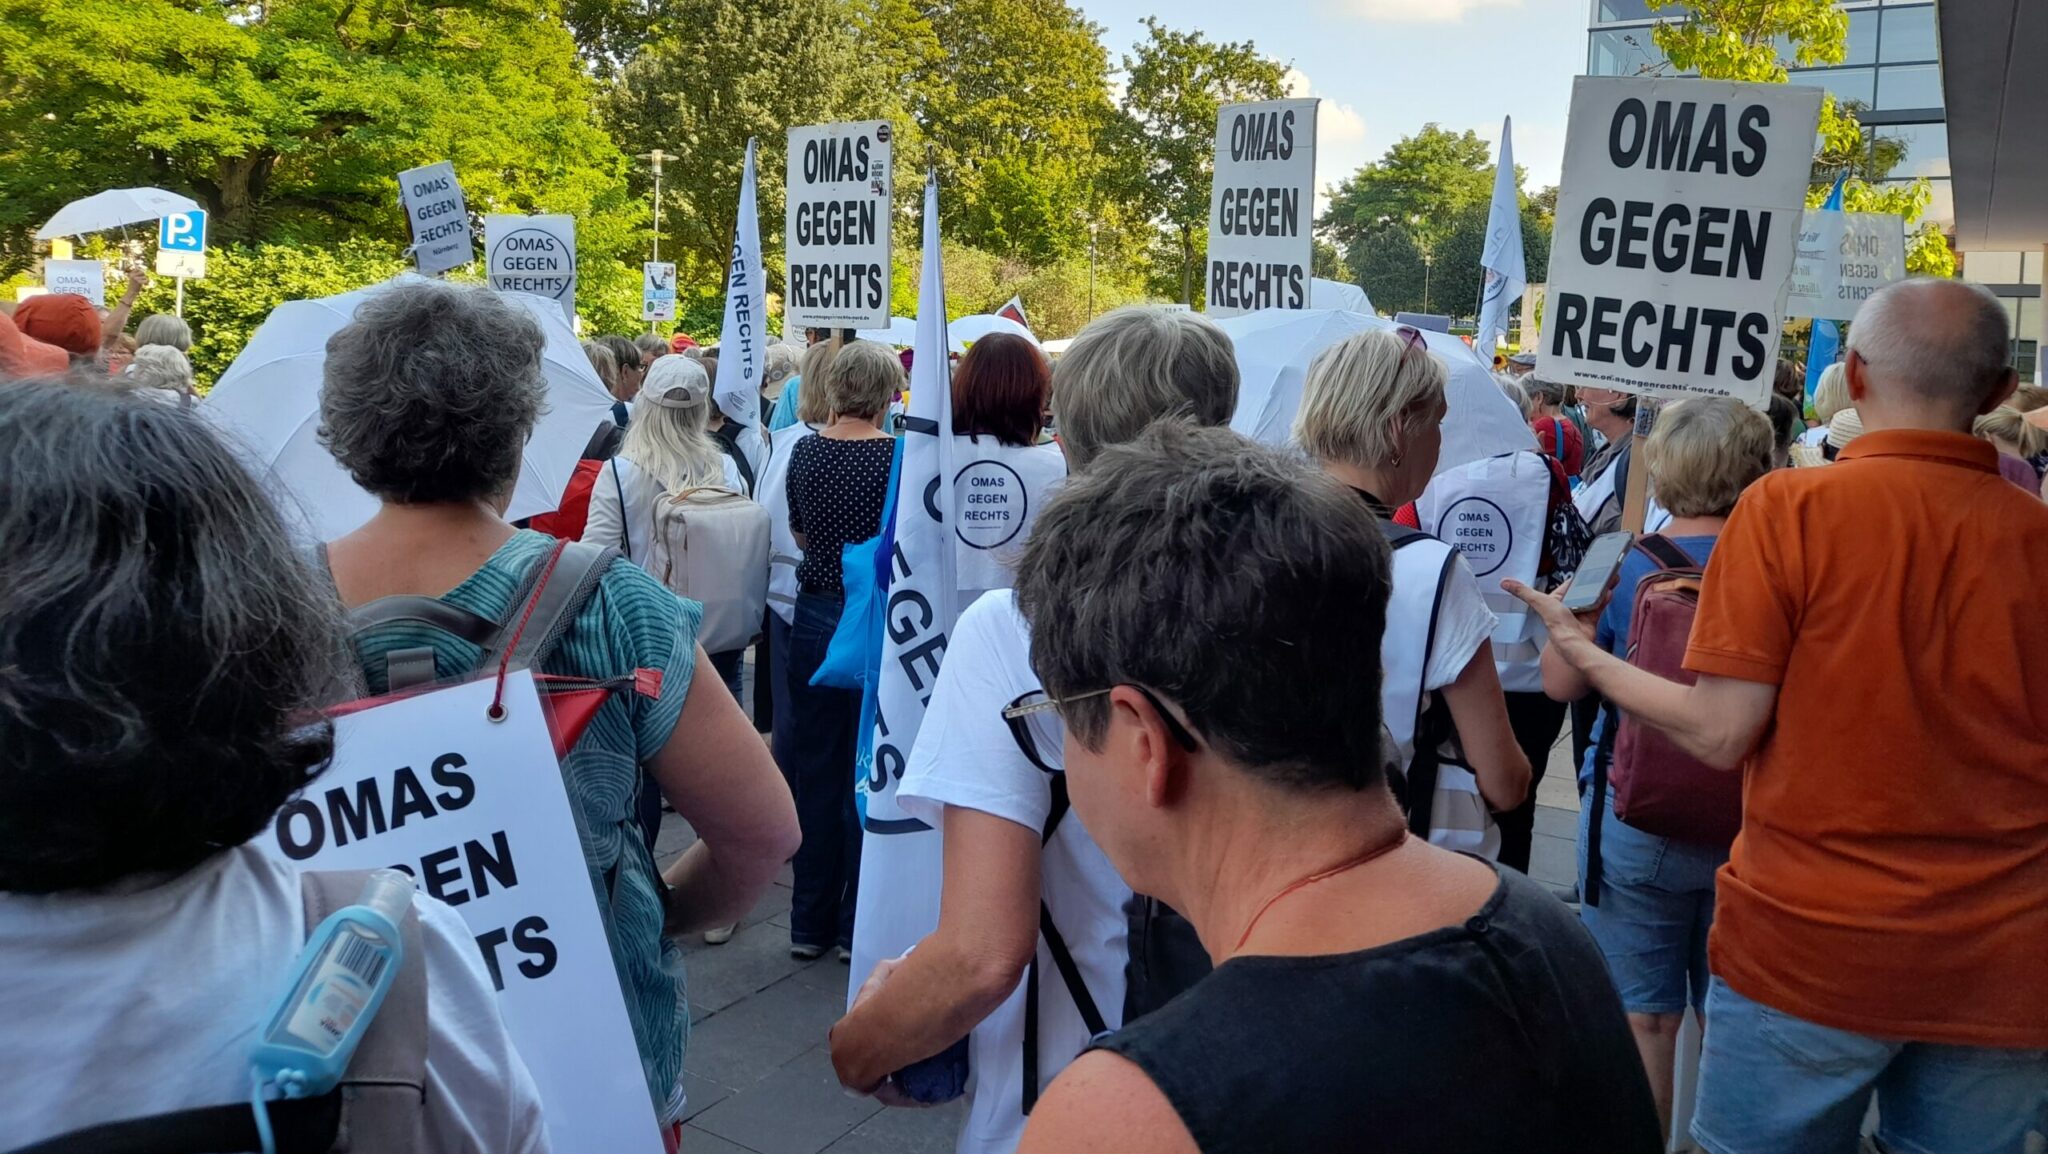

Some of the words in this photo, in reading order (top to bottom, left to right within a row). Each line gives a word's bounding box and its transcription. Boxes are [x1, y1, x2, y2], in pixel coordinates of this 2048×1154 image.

[1231, 110, 1295, 162] OMAS
[1609, 98, 1770, 177] OMAS
[804, 135, 870, 184] OMAS
[413, 177, 449, 198] OMAS
[418, 198, 457, 221] GEGEN
[1219, 187, 1299, 237] GEGEN
[166, 213, 193, 245] P
[420, 219, 464, 244] RECHTS
[796, 200, 876, 246] GEGEN
[505, 237, 555, 251] OMAS
[1580, 197, 1772, 281] GEGEN
[503, 257, 558, 271] GEGEN
[53, 286, 91, 295] GEGEN
[56, 276, 87, 285] OMAS
[503, 277, 563, 291] RECHTS
[791, 263, 882, 309] RECHTS
[1211, 260, 1304, 310] RECHTS
[733, 294, 754, 381] RECHTS
[1552, 292, 1769, 381] RECHTS
[971, 477, 1005, 487] OMAS
[967, 494, 1008, 504] GEGEN
[964, 510, 1010, 521] RECHTS
[1458, 512, 1490, 522] OMAS
[1455, 527, 1493, 537] GEGEN
[1453, 542, 1496, 553] RECHTS
[275, 752, 476, 861] OMAS
